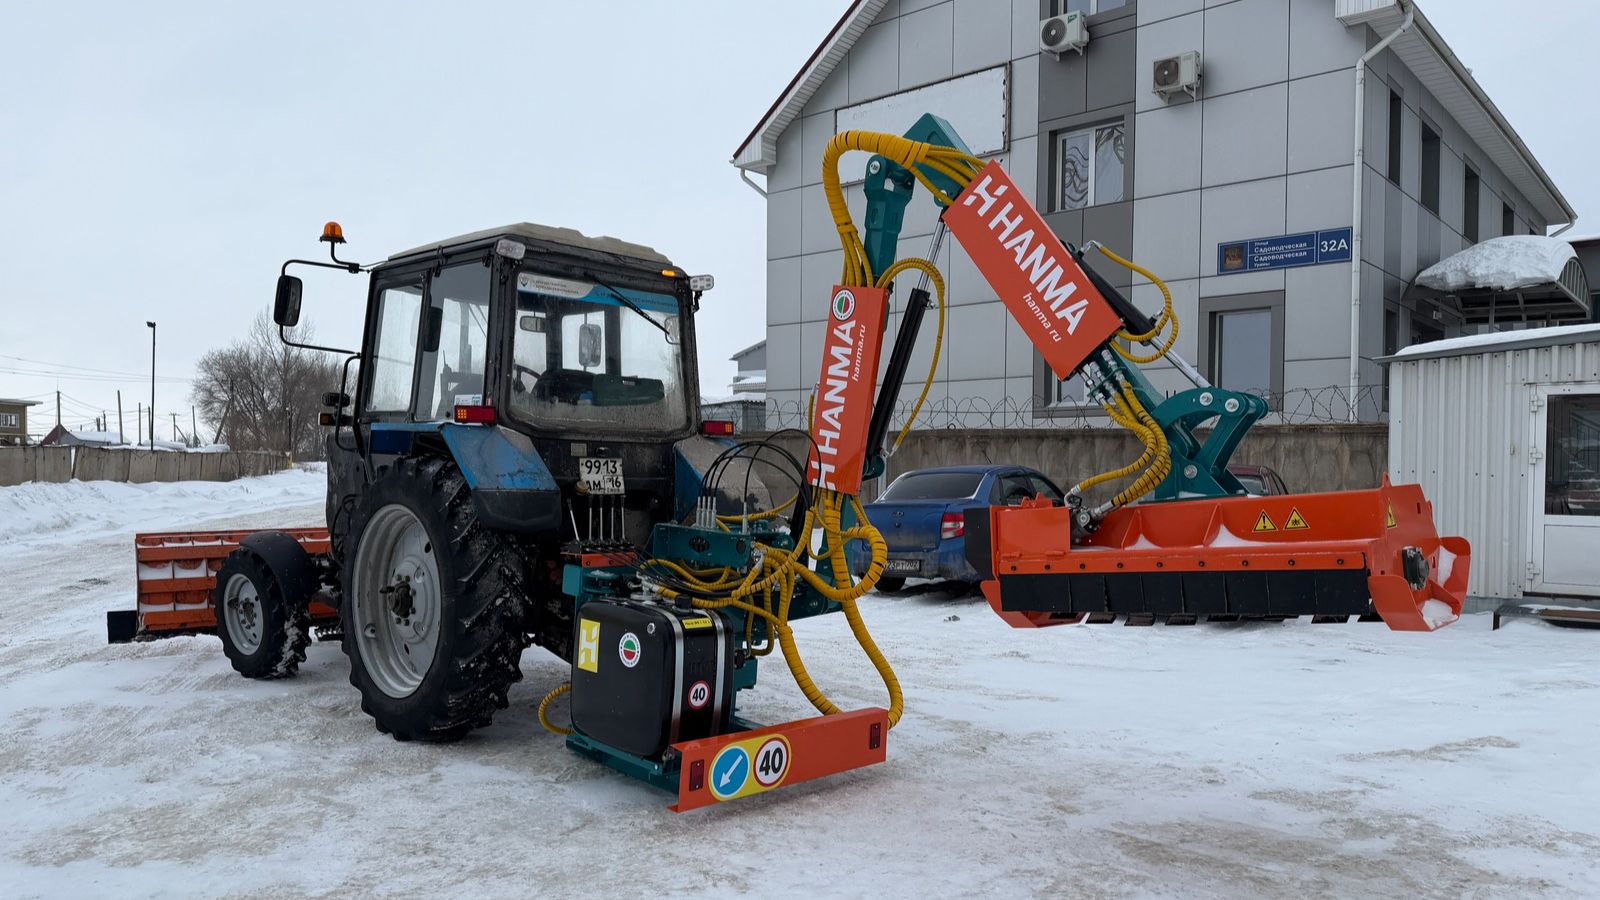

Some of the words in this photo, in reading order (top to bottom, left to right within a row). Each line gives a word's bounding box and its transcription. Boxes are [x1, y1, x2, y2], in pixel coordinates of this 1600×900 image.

[1254, 242, 1307, 254] Садоводческая
[1254, 250, 1307, 262] Садоводческая
[988, 201, 1089, 336] HANMA
[851, 324, 866, 382] hanma.ru
[817, 320, 856, 456] HANMA
[585, 460, 617, 475] 9913
[692, 687, 706, 702] 40
[758, 747, 784, 776] 40
